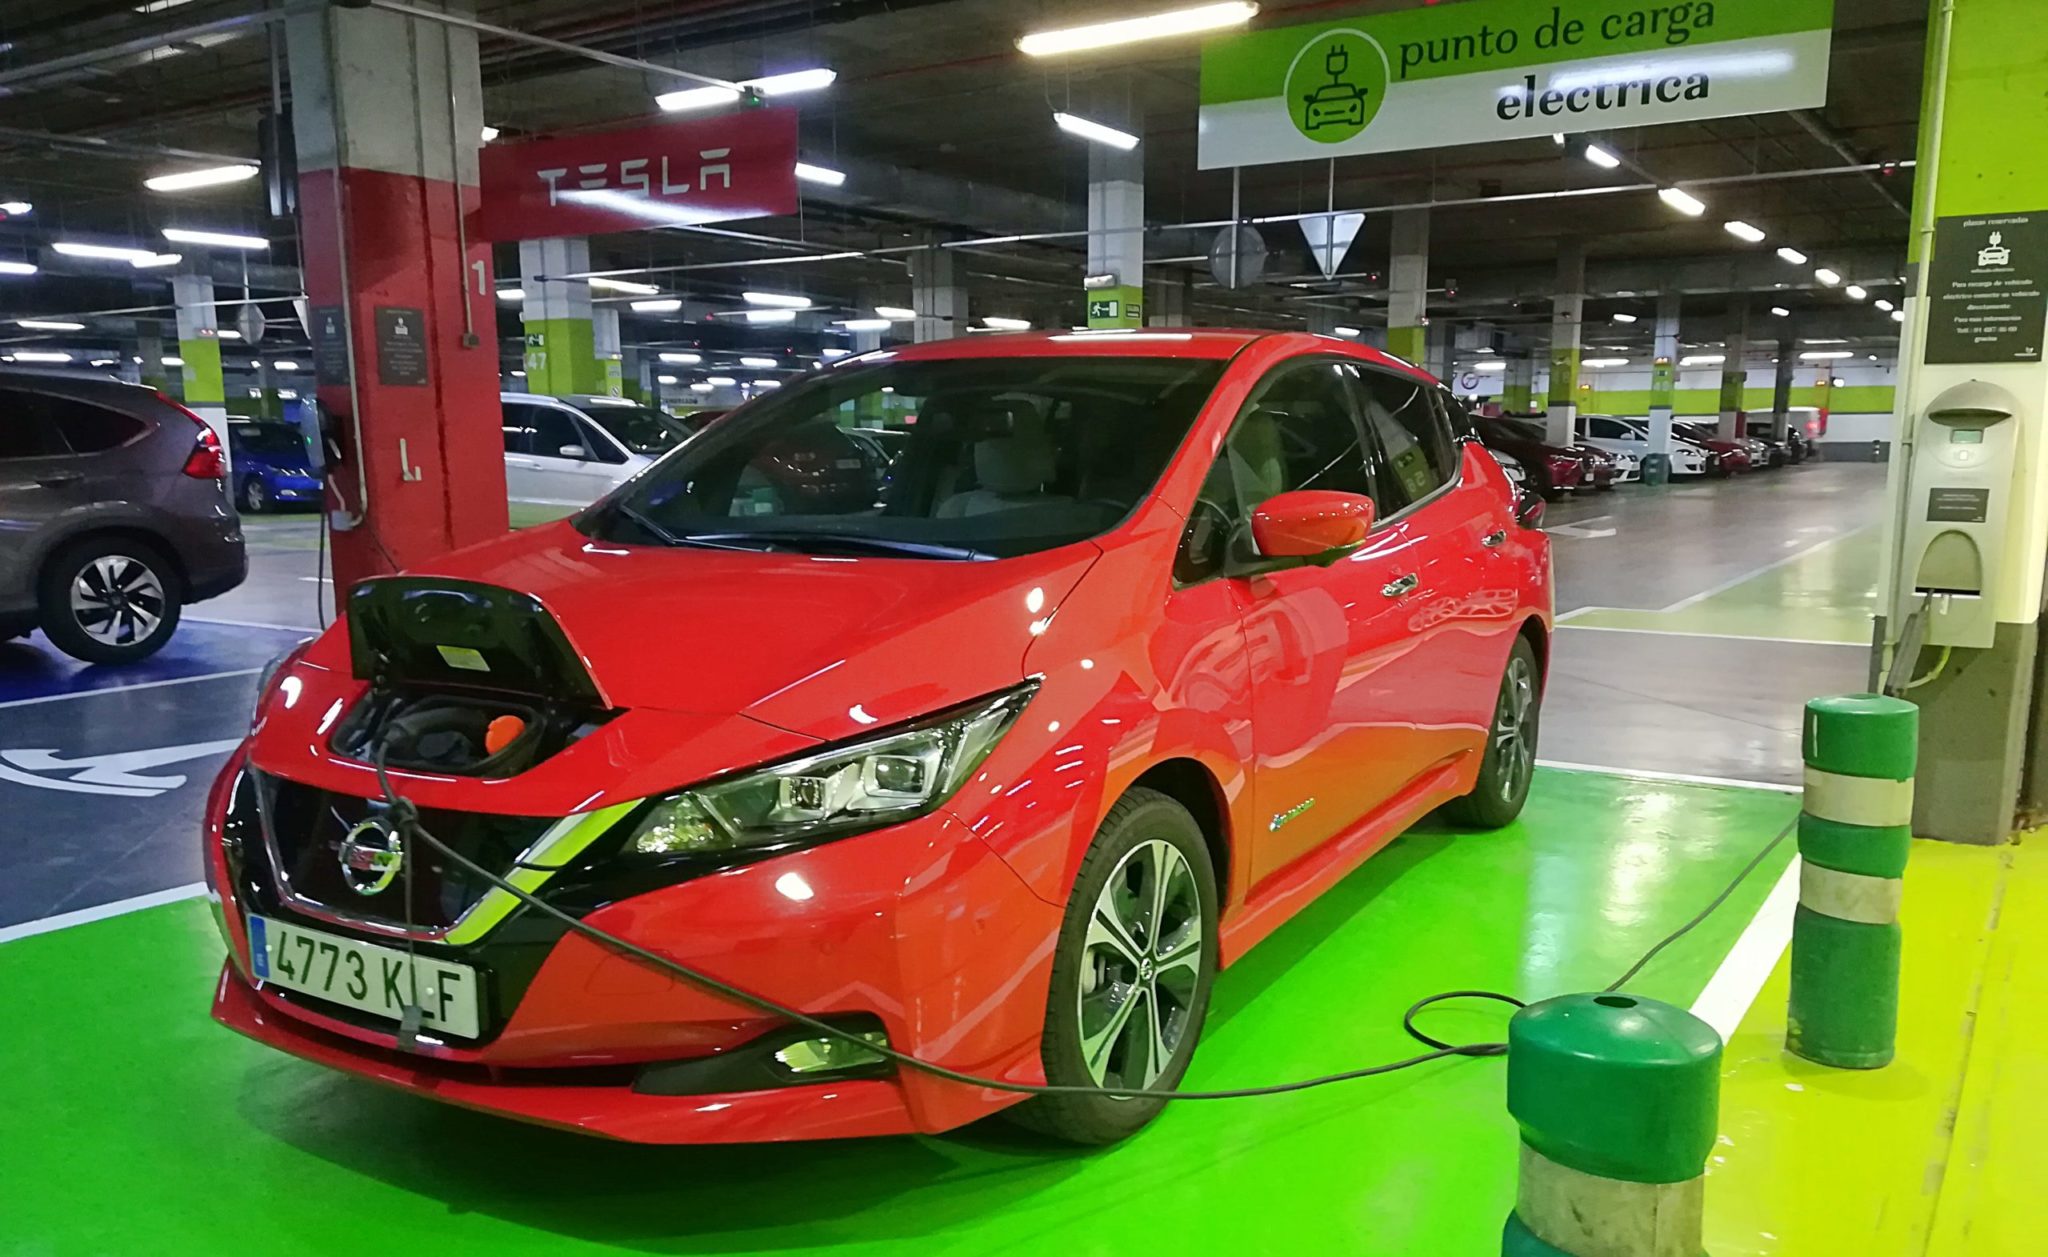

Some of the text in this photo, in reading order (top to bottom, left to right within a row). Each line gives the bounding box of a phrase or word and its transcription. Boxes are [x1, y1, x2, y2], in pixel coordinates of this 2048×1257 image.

[1400, 1, 1715, 78] punto de carga
[1496, 72, 1709, 120] electrica
[537, 148, 730, 206] TESLA
[472, 260, 486, 296] 1
[528, 352, 546, 370] 47
[276, 931, 461, 1022] 4773 KLF
